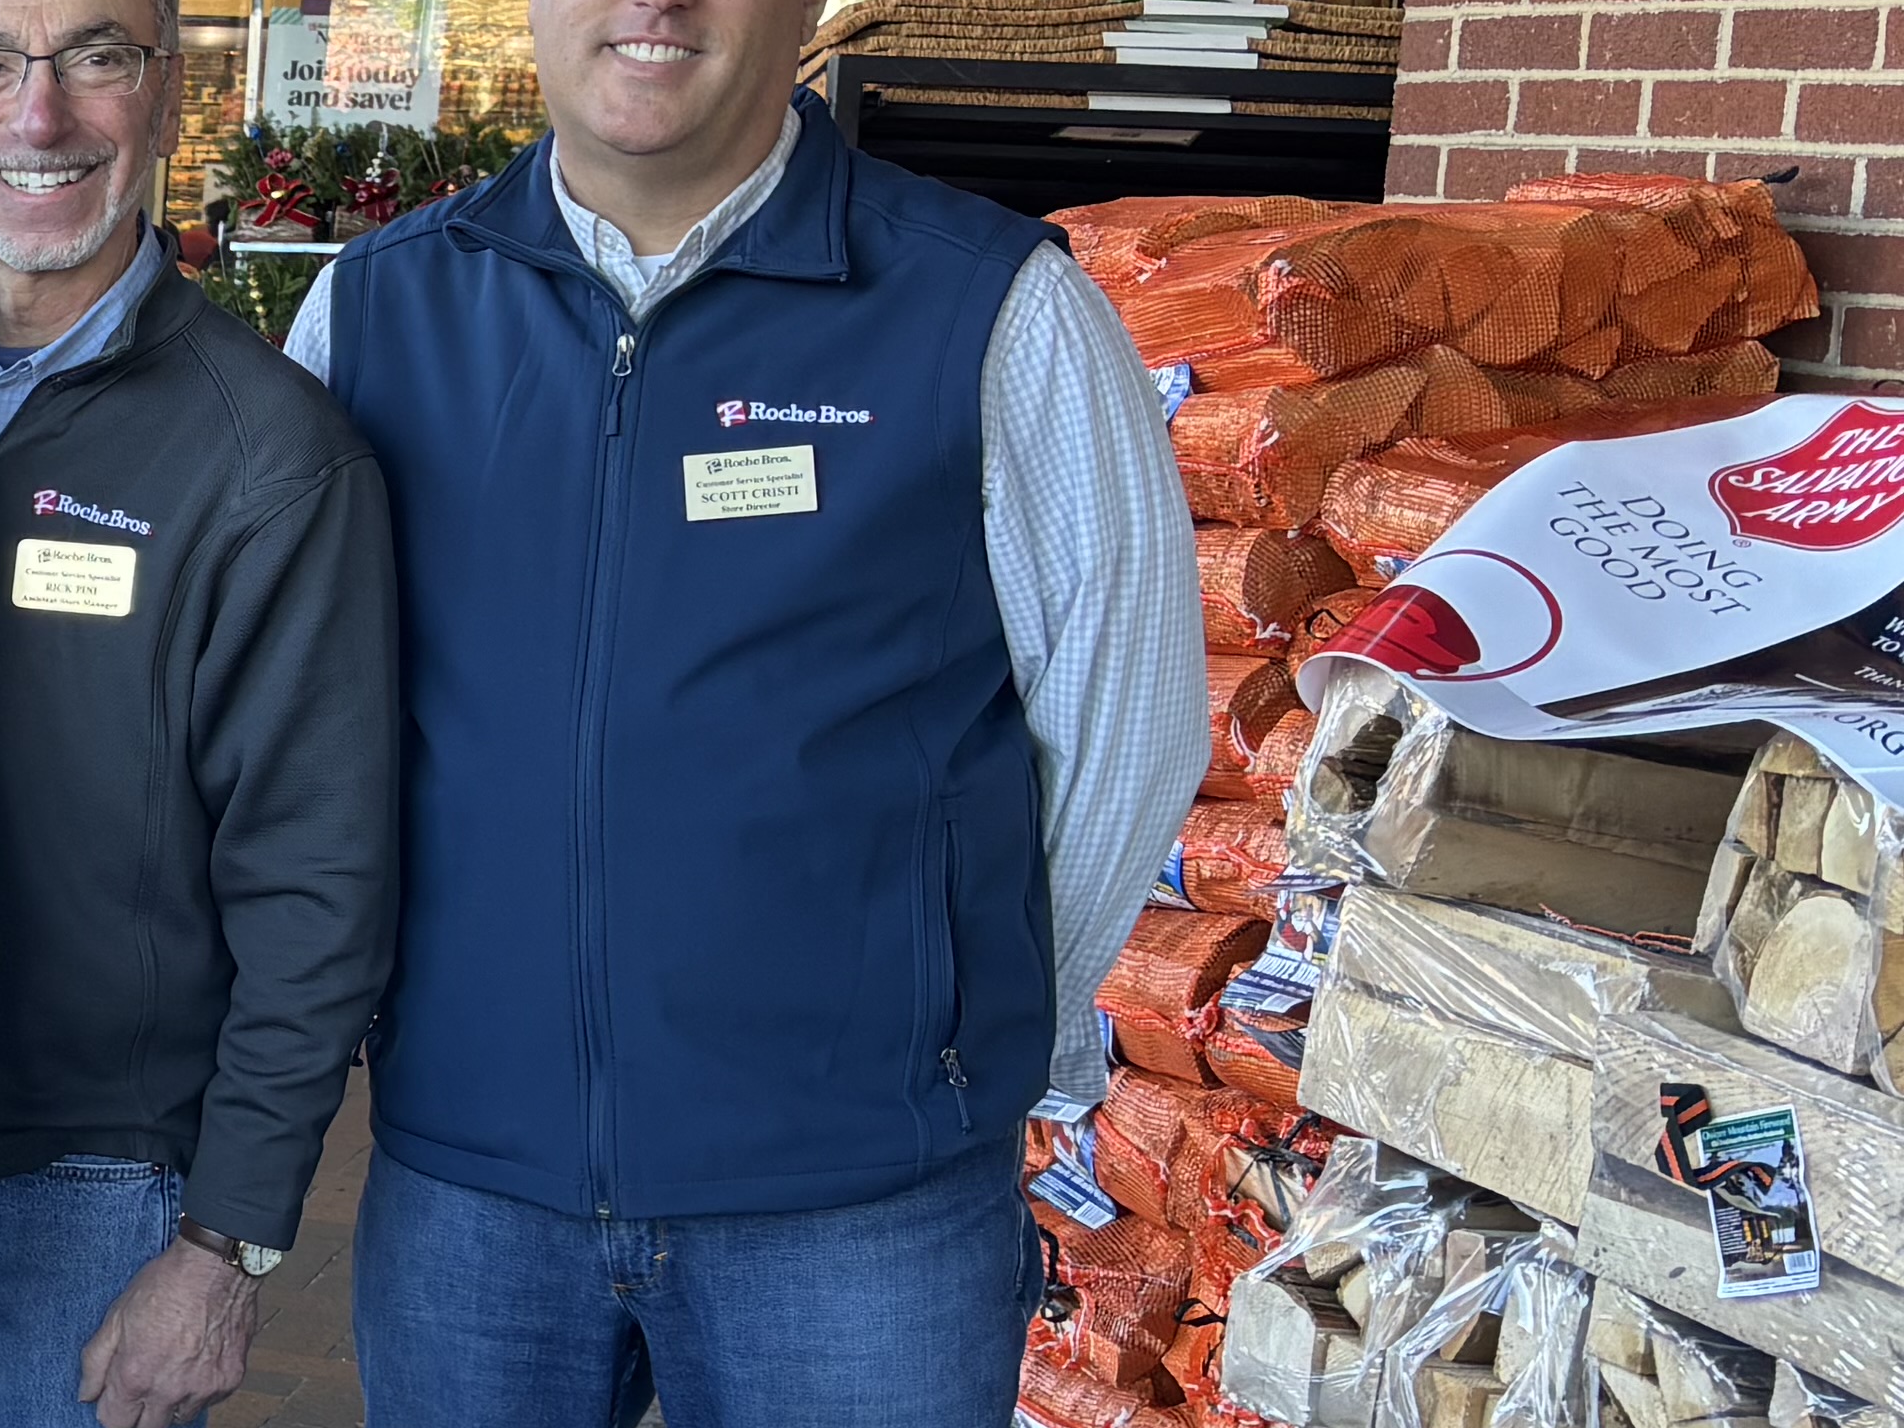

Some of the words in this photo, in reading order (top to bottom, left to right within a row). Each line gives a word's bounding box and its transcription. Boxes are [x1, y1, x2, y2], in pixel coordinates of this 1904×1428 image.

[287, 88, 340, 107] and
[343, 90, 413, 111] save!
[749, 401, 817, 422] Roche
[817, 405, 874, 424] Bros.
[55, 494, 109, 525] Roche
[701, 490, 748, 503] SCOTT
[1740, 488, 1904, 529] ARMY
[1549, 517, 1667, 600] GOOD
[1557, 481, 1638, 536] THE
[1628, 545, 1751, 615] MOST
[1618, 495, 1764, 588] DOING
